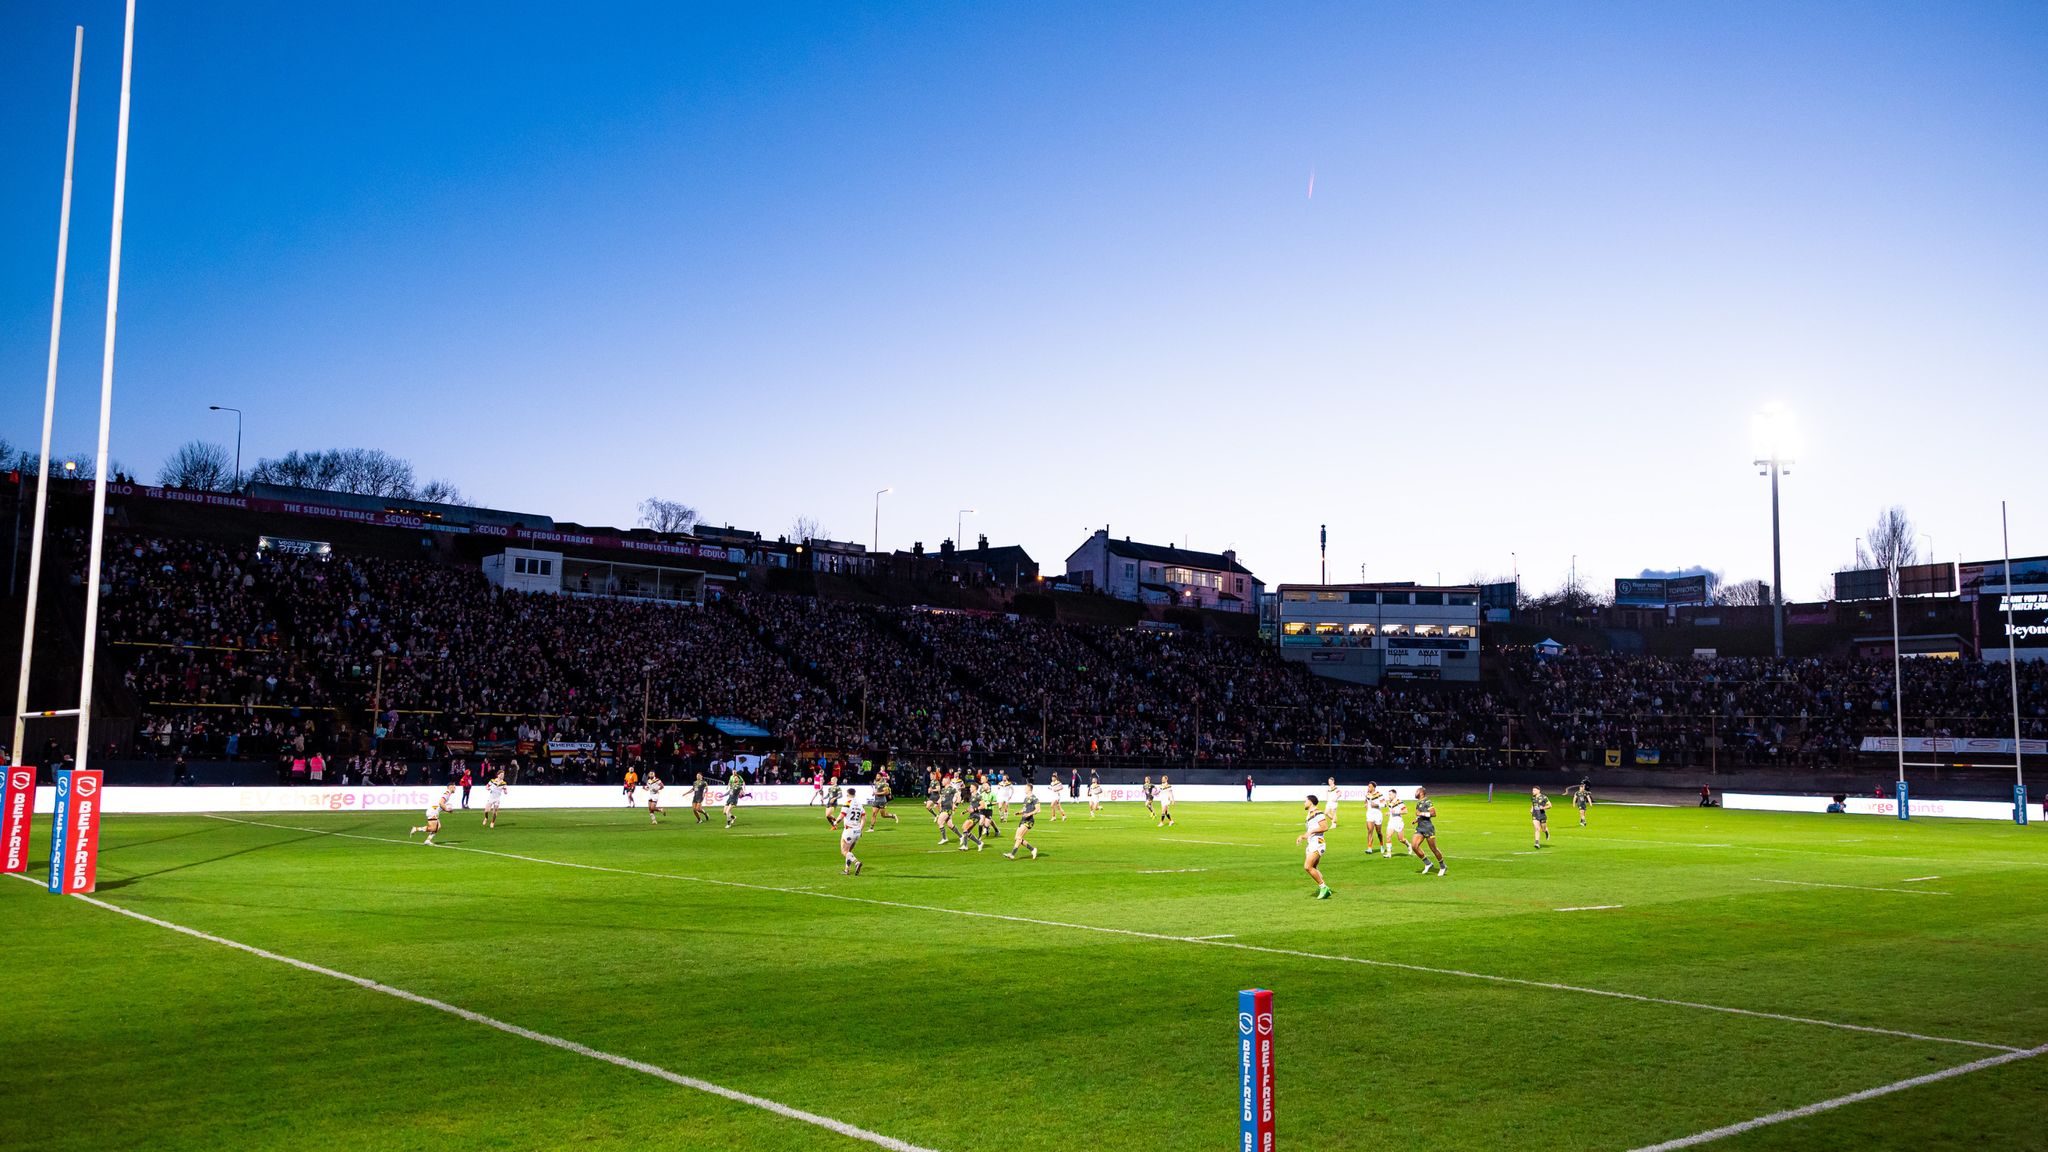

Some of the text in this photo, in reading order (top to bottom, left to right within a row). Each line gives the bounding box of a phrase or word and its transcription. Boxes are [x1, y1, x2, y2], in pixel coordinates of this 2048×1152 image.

[87, 482, 132, 495] SULO
[145, 488, 248, 508] THE SEDULO TERRACE
[283, 503, 375, 521] THE SEDULO TERRACE
[384, 514, 421, 526] SEDULO
[516, 530, 594, 545] THE SEDULO TERRACE
[621, 540, 692, 555] THE SEDULO TERRACE
[698, 548, 727, 559] SEDULO
[2004, 623, 2048, 640] Beyon
[280, 789, 356, 809] charge
[362, 789, 430, 808] points
[850, 811, 861, 821] 23
[7, 793, 25, 869] BETFRED
[52, 801, 65, 889] BETFRED
[72, 801, 92, 890] BETFRED
[1243, 1040, 1252, 1121] BETFRED
[1261, 1040, 1271, 1122] BETFRED
